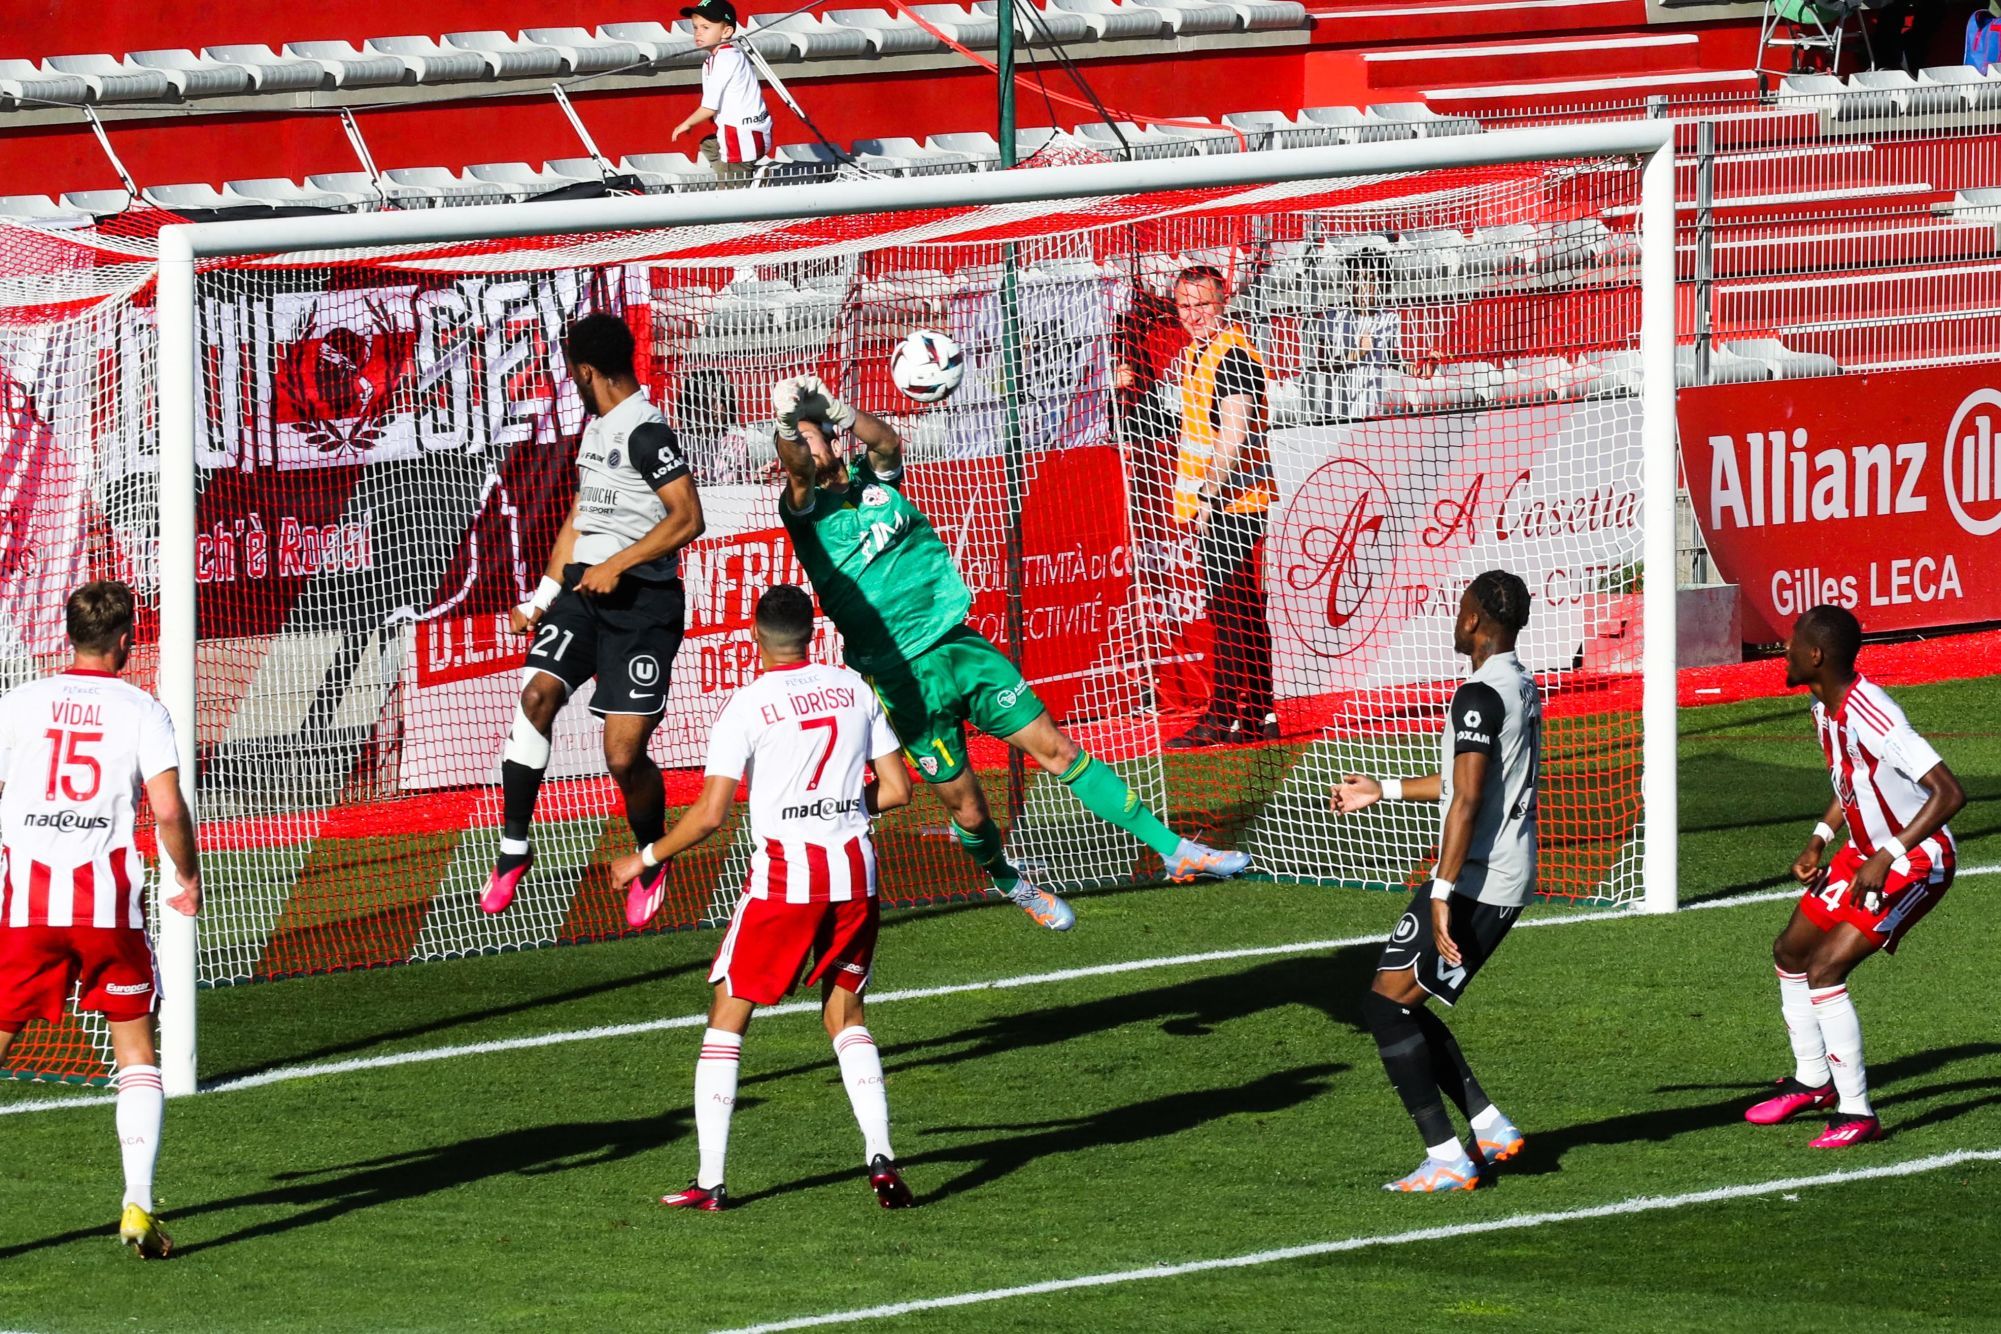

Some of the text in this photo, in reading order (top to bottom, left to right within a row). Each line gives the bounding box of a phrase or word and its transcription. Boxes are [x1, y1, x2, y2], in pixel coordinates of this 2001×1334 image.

[1708, 427, 1927, 530] Allianz
[278, 507, 373, 578] Rossi
[966, 542, 1087, 594] CULLTTIVITÀ
[1771, 554, 1964, 616] Gilles LECA
[530, 623, 575, 662] 21
[760, 703, 786, 726] EL
[43, 727, 104, 802] 15
[799, 715, 839, 791] 7
[931, 737, 955, 767] 1
